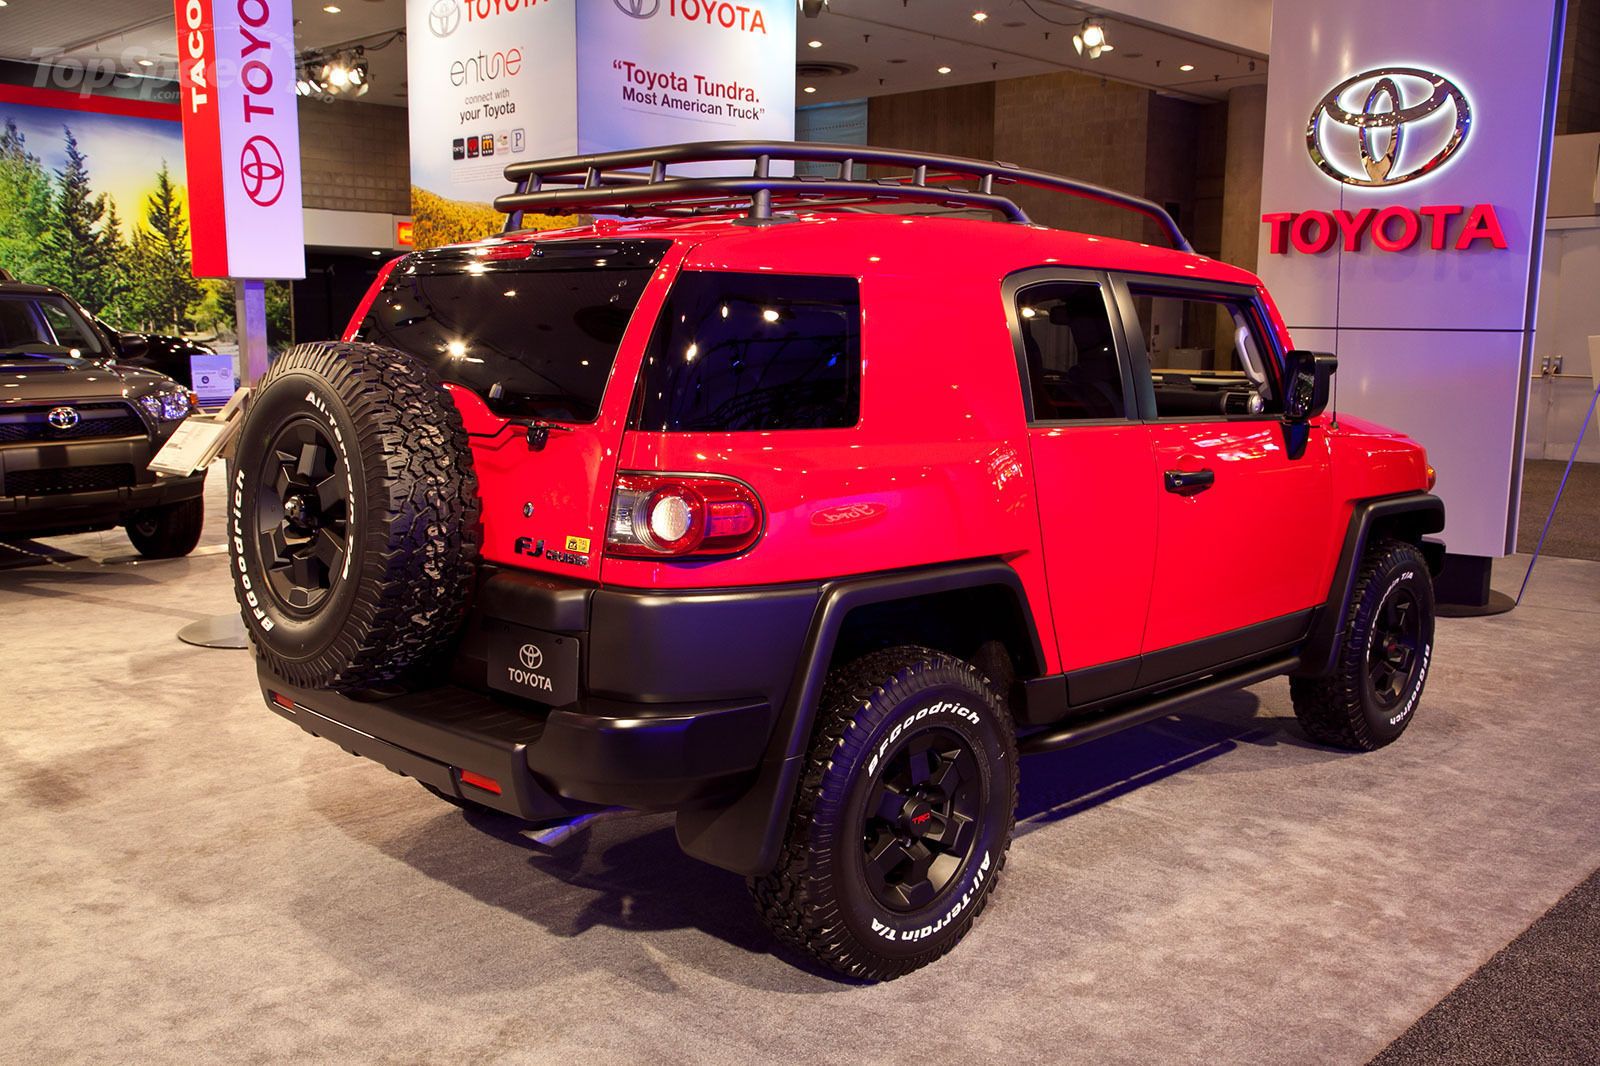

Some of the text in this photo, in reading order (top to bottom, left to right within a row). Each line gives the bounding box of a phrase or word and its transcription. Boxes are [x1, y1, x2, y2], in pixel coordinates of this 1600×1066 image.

[668, 0, 767, 34] TOYOTA
[450, 48, 522, 87] entune
[464, 87, 510, 105] connect with
[622, 86, 658, 106] Most
[661, 93, 723, 116] American
[694, 75, 760, 103] Tundra.
[459, 101, 516, 125] your Toyota
[1261, 203, 1508, 255] TOYOTA
[514, 536, 545, 557] FJ
[507, 667, 553, 692] TOYOTA
[867, 700, 981, 778] BFGoodrich
[870, 917, 897, 942] T/A
